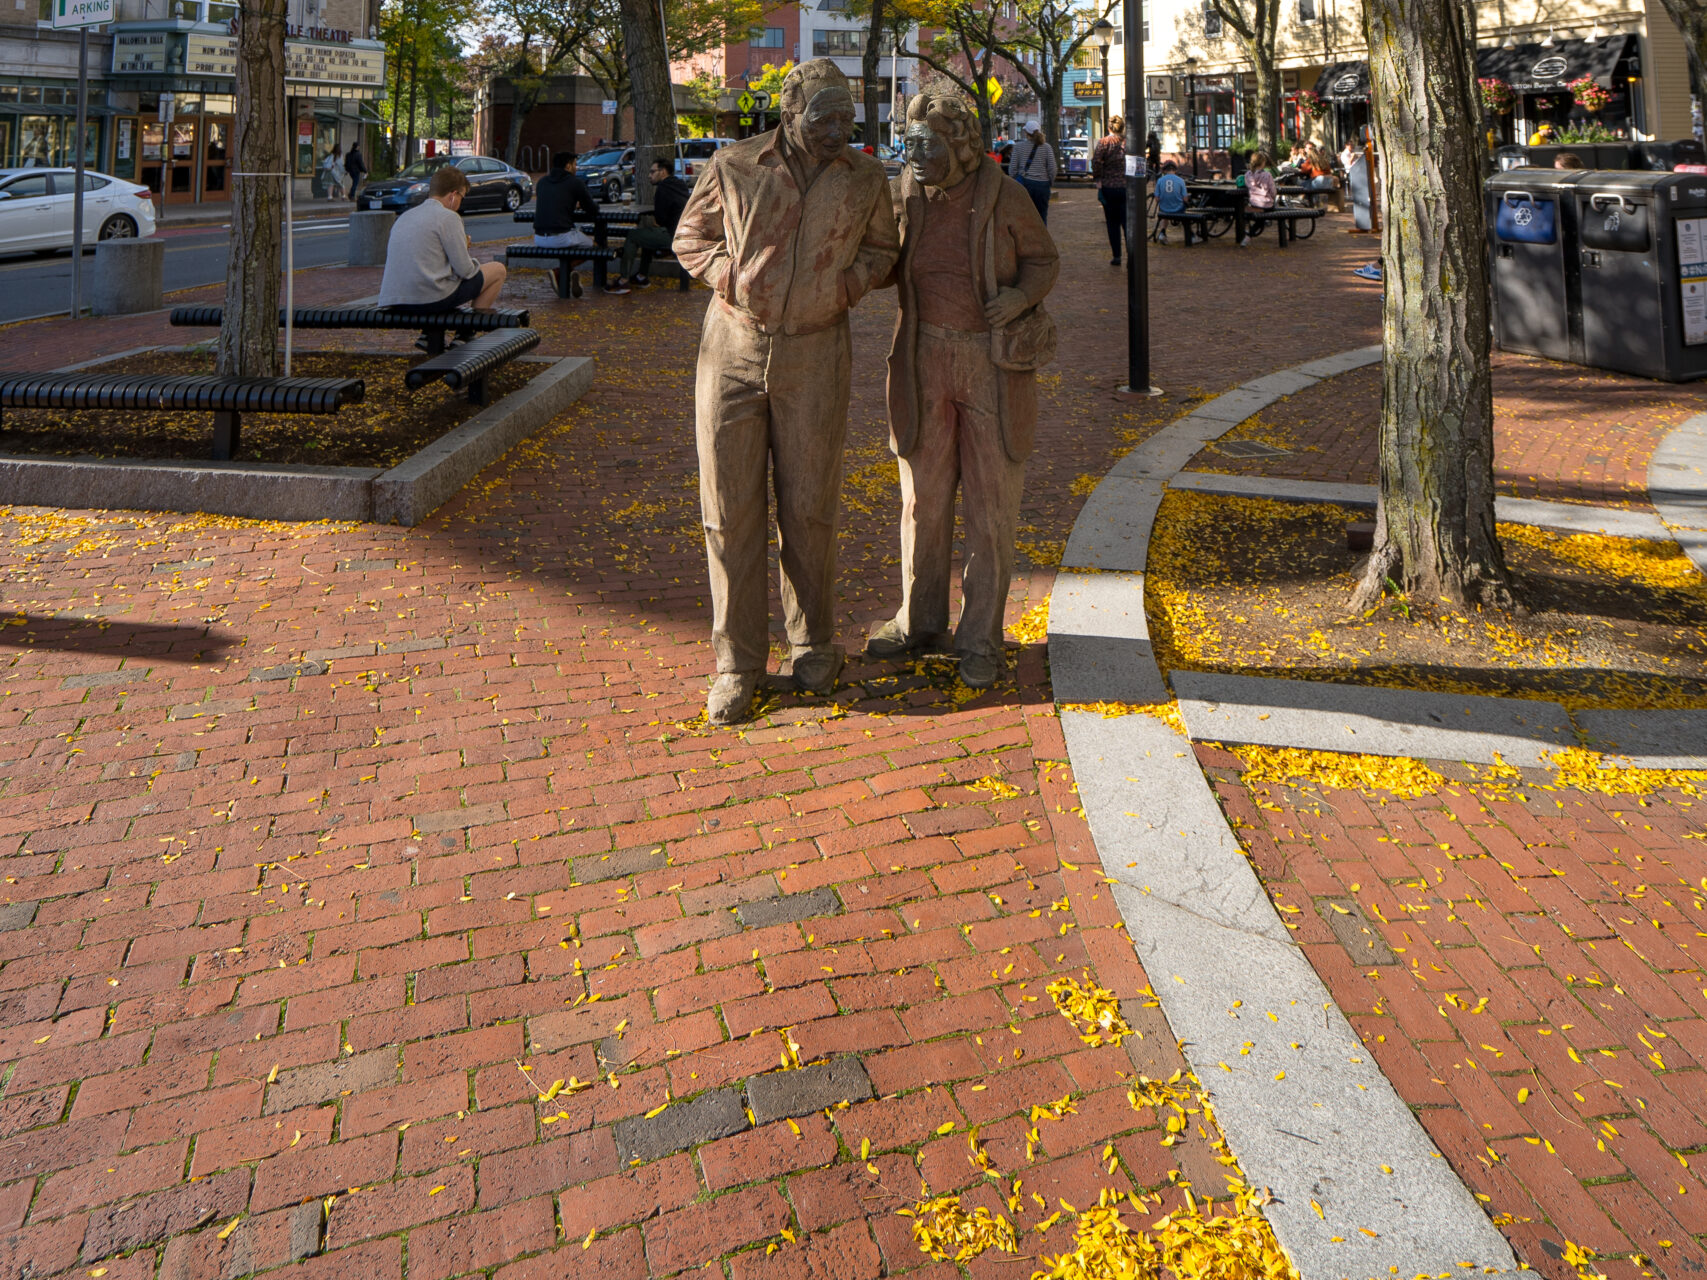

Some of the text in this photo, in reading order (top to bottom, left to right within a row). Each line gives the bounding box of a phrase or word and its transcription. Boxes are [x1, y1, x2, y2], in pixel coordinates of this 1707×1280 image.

[309, 26, 353, 43] THEATRE
[755, 96, 767, 108] T
[1165, 180, 1173, 192] 8
